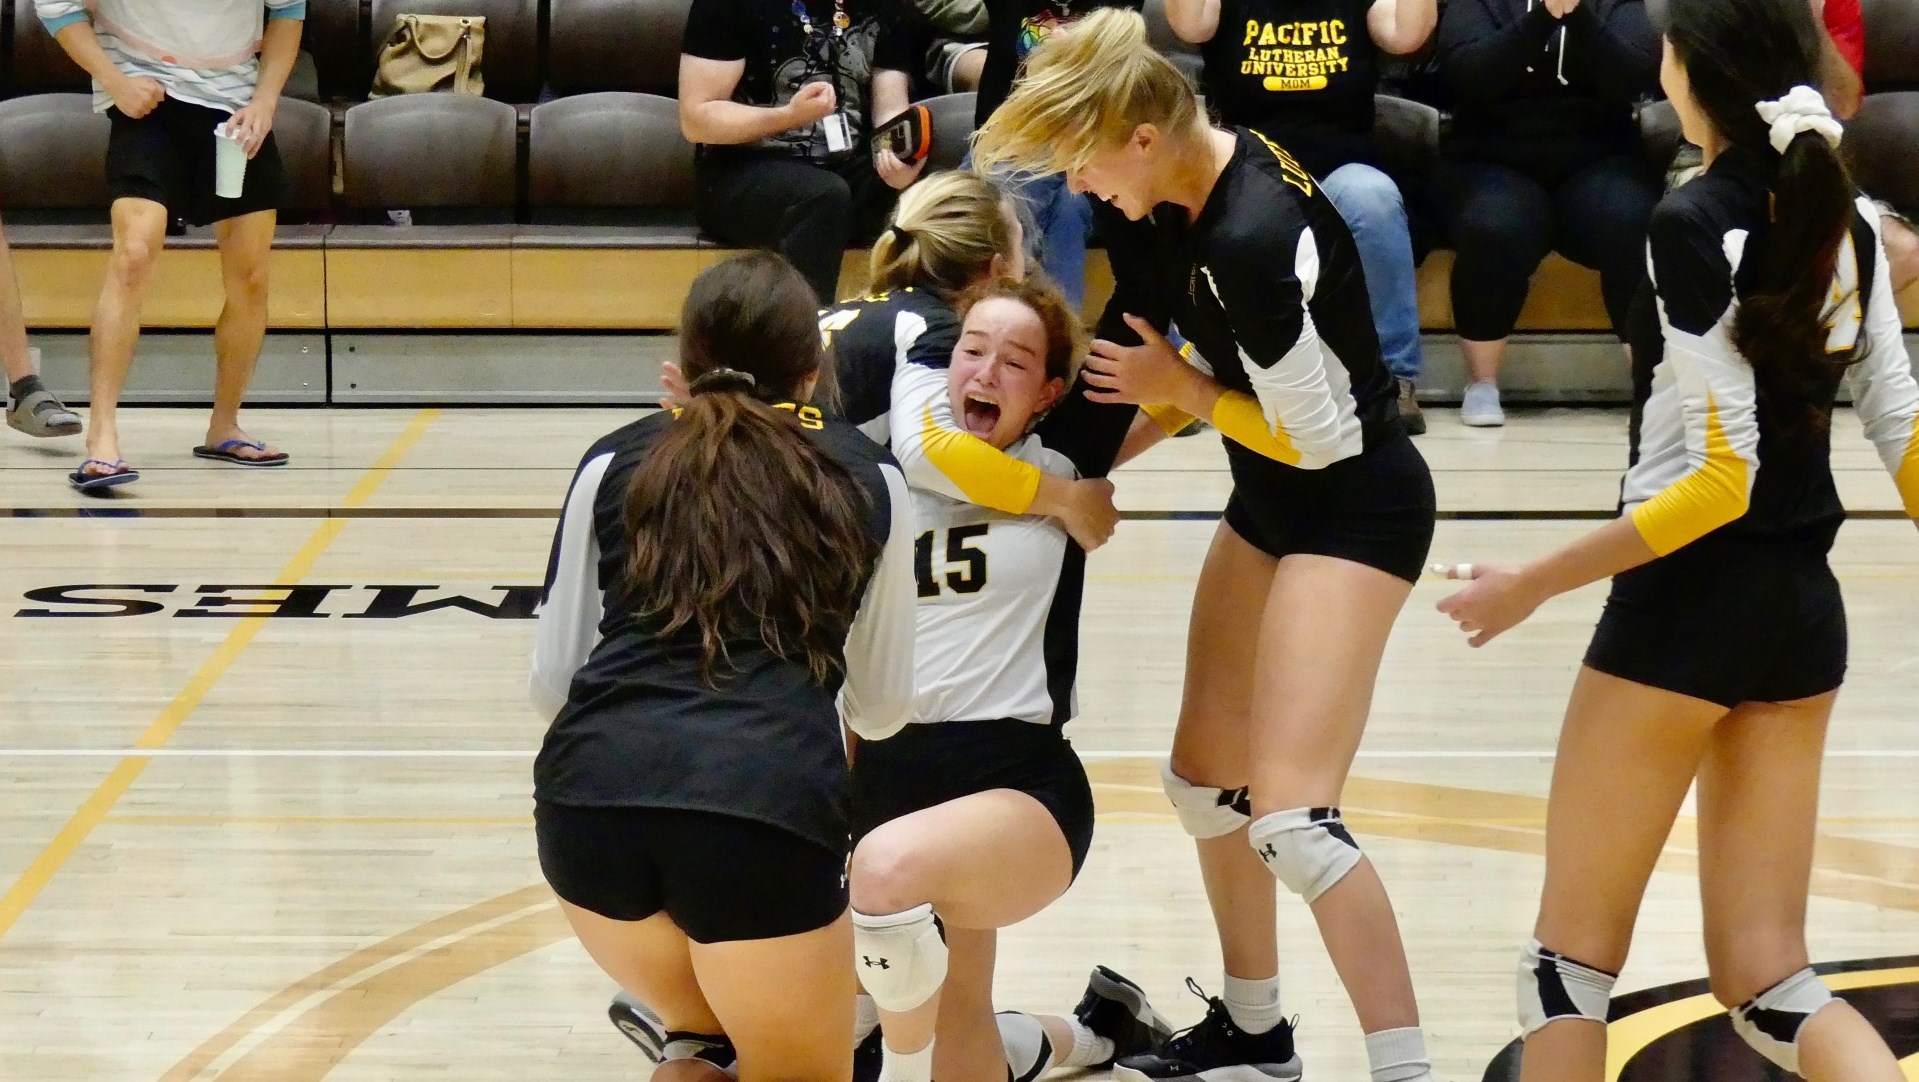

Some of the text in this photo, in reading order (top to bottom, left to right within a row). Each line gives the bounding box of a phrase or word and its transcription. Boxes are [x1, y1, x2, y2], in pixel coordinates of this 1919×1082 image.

[1242, 19, 1348, 46] PACIFIC
[1248, 47, 1340, 63] LUTHERAN
[1240, 57, 1349, 77] UNIVERSITY
[1280, 79, 1311, 89] MOM
[914, 521, 991, 600] 15
[13, 583, 542, 619] MES
